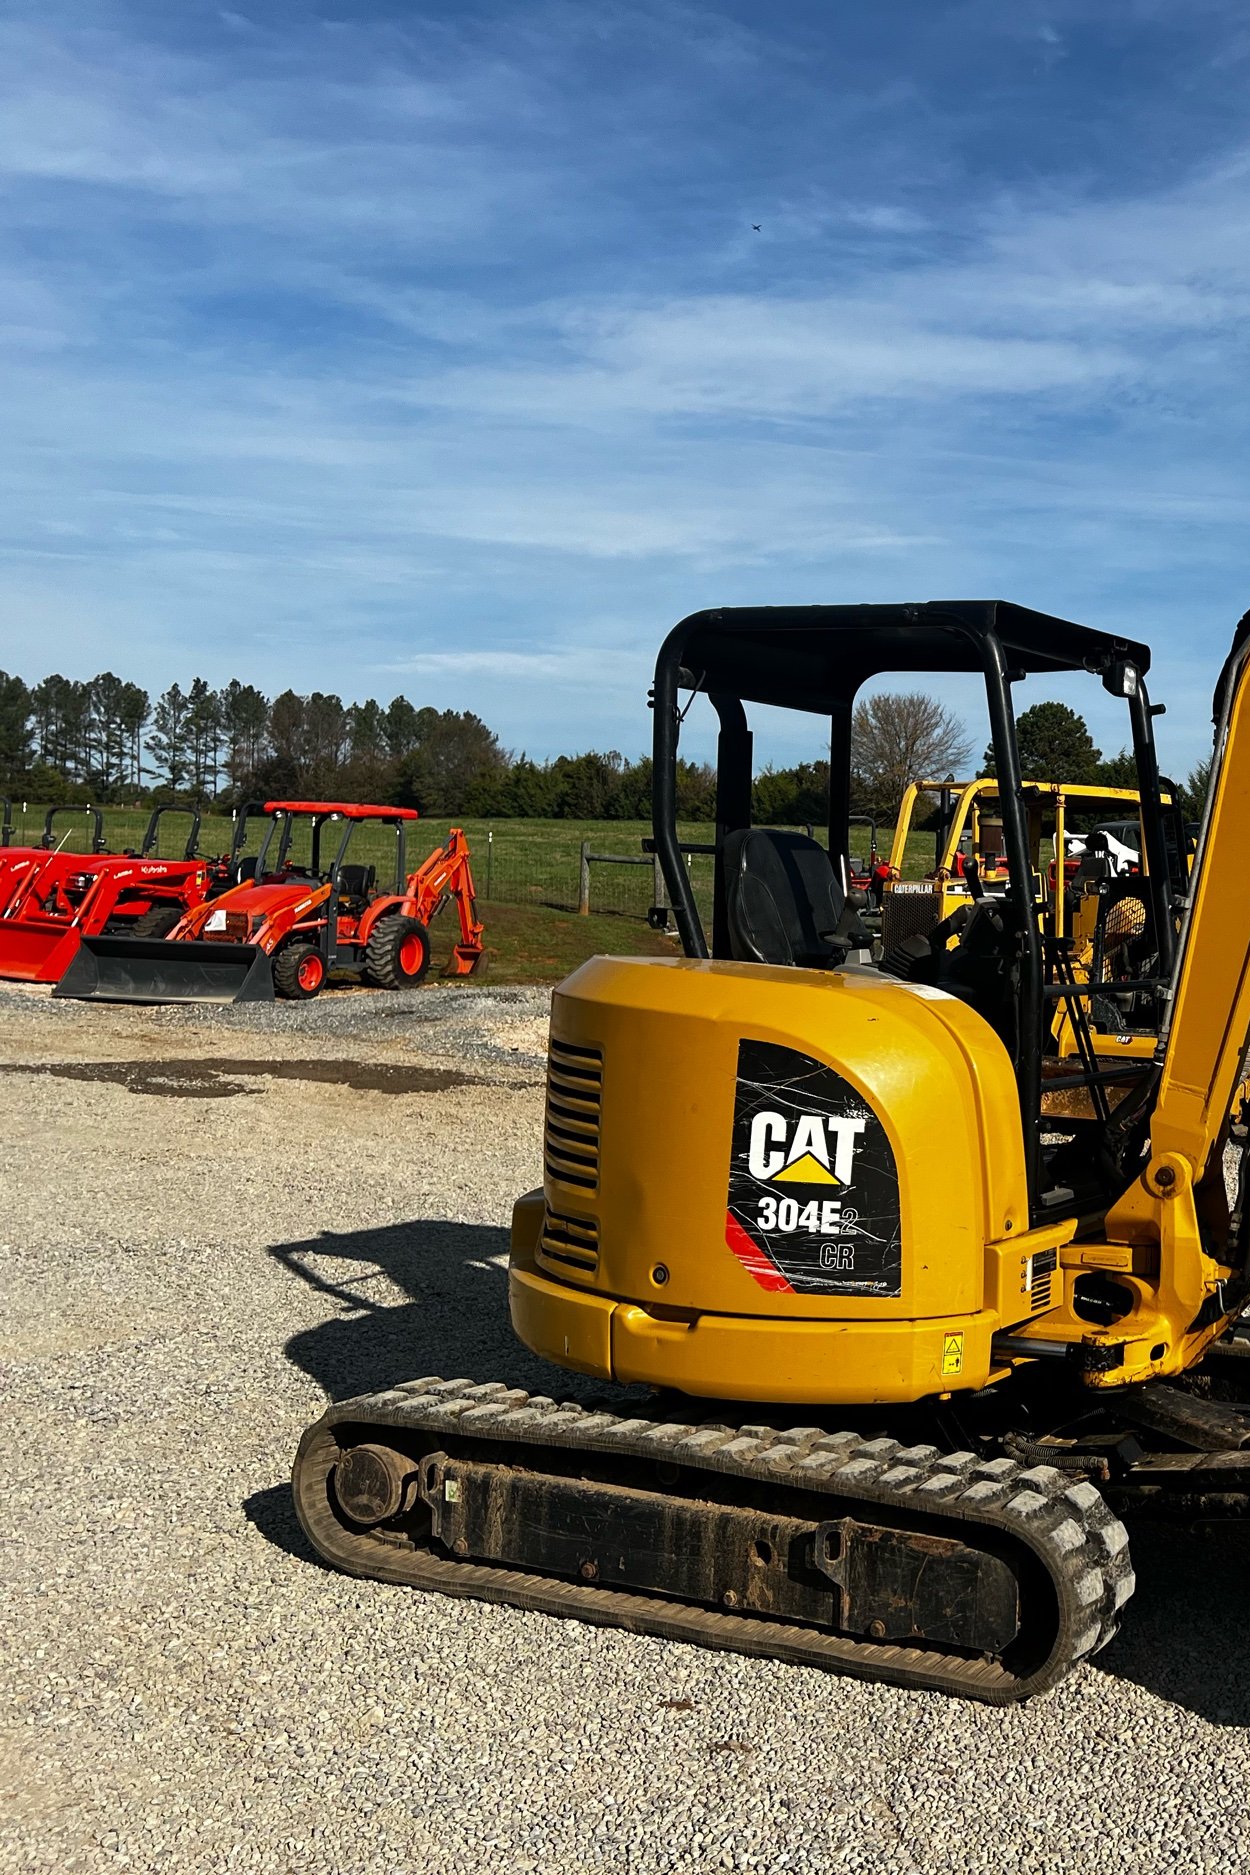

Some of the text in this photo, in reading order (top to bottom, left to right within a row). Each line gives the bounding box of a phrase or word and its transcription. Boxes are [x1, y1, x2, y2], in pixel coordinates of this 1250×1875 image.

[894, 884, 933, 894] CATERPILLAR
[1116, 1035, 1131, 1043] CAT
[749, 1111, 866, 1186] CAT
[819, 1242, 855, 1270] CR
